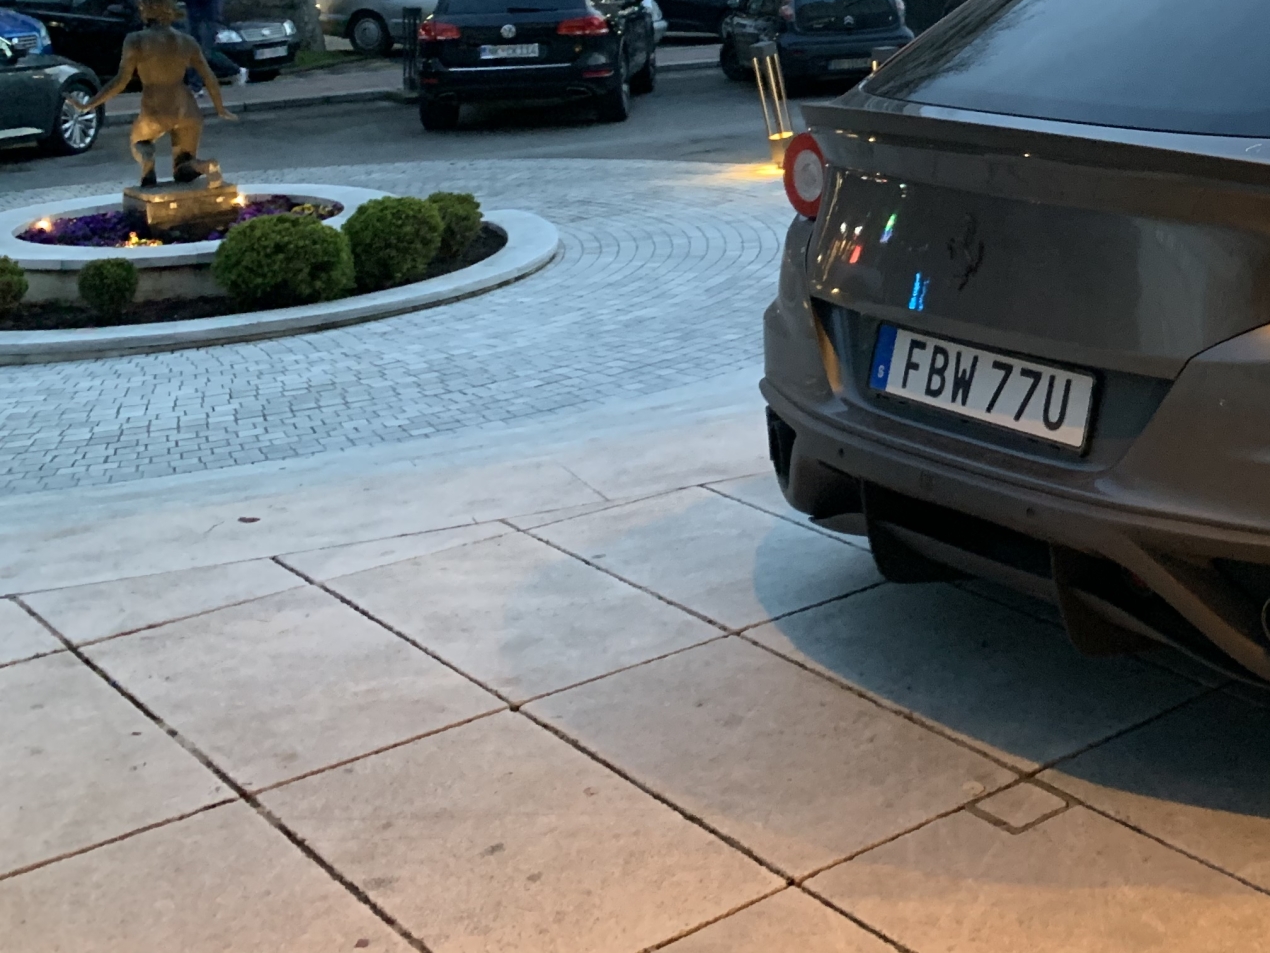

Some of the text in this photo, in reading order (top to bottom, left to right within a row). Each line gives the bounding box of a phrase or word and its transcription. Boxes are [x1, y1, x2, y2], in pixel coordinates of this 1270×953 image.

[876, 364, 885, 379] S
[901, 338, 1072, 431] FBW 77U
